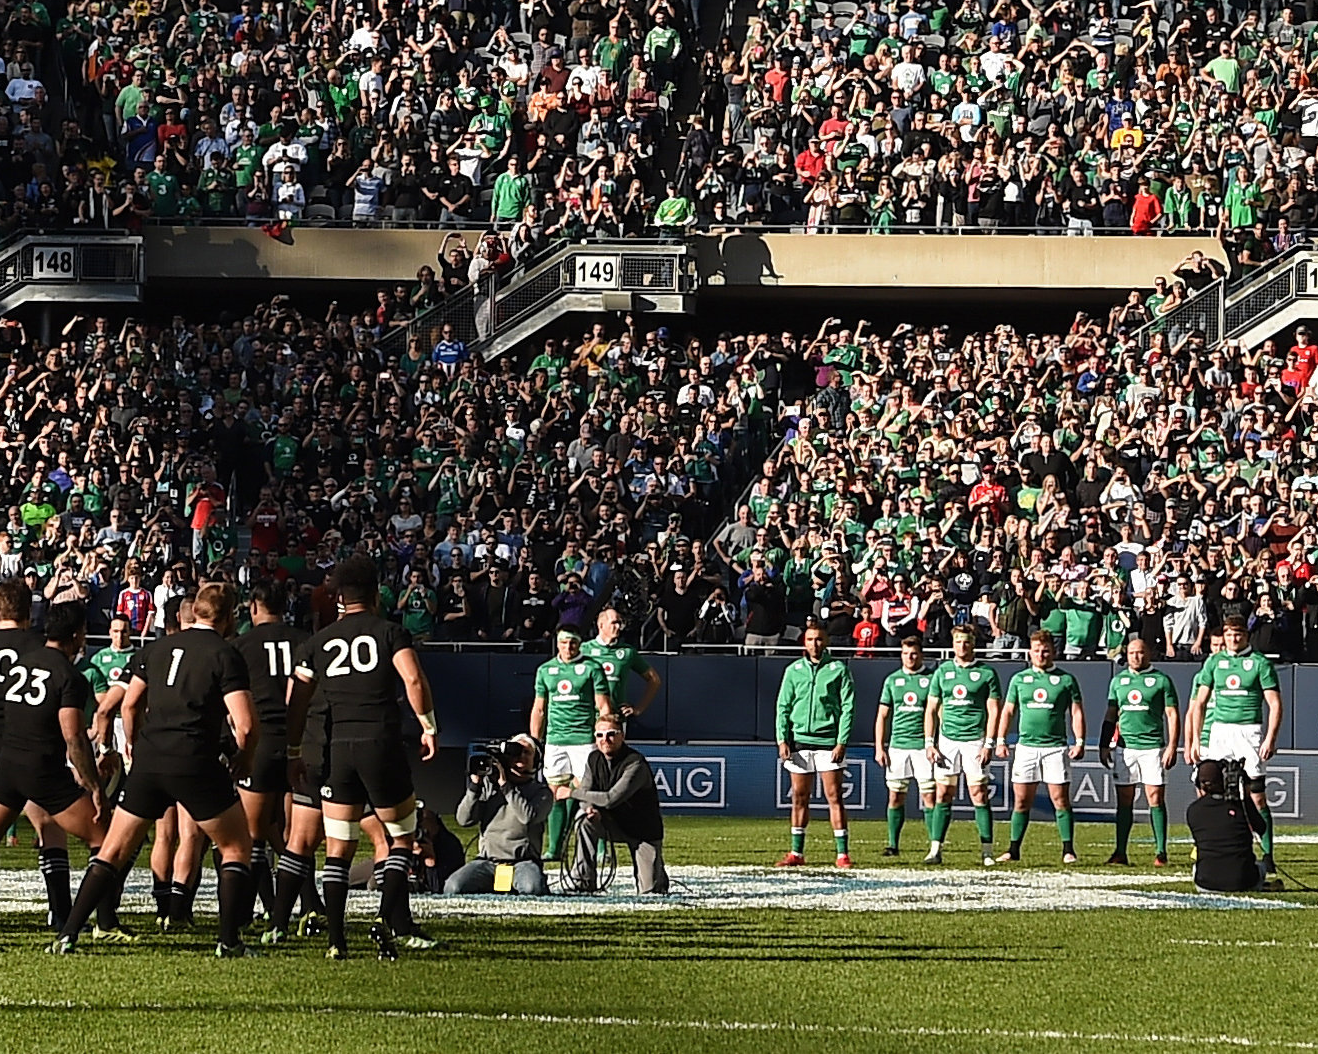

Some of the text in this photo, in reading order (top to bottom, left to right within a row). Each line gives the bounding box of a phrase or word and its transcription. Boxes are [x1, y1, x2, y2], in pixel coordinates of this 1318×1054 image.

[35, 251, 72, 273] 148
[578, 261, 614, 283] 149
[166, 648, 184, 686] 1
[263, 640, 292, 677] 11
[322, 634, 379, 678] 20
[5, 665, 52, 706] 23
[654, 767, 714, 798] AIG
